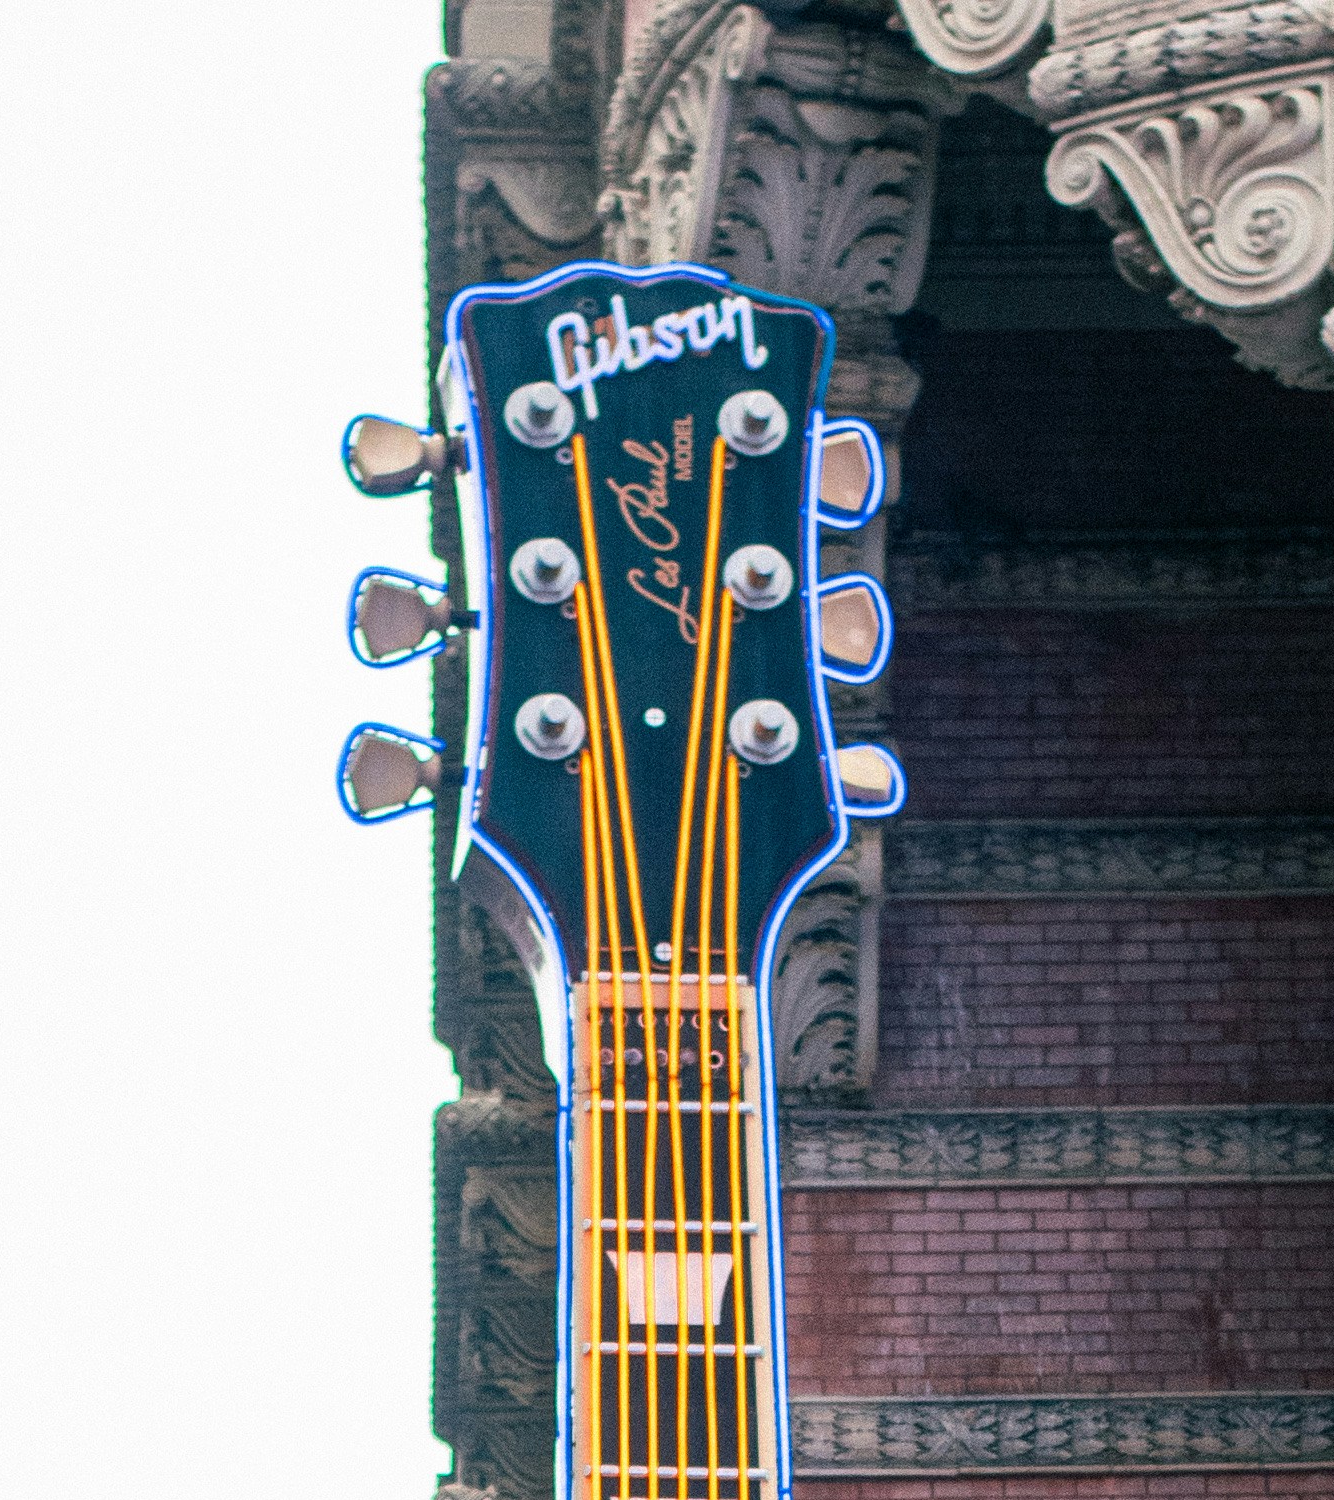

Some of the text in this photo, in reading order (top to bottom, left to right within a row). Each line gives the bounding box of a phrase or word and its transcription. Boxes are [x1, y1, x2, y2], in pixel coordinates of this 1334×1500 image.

[547, 294, 767, 420] Gibson
[673, 414, 694, 481] MODEL
[606, 439, 700, 644] Les Paul
